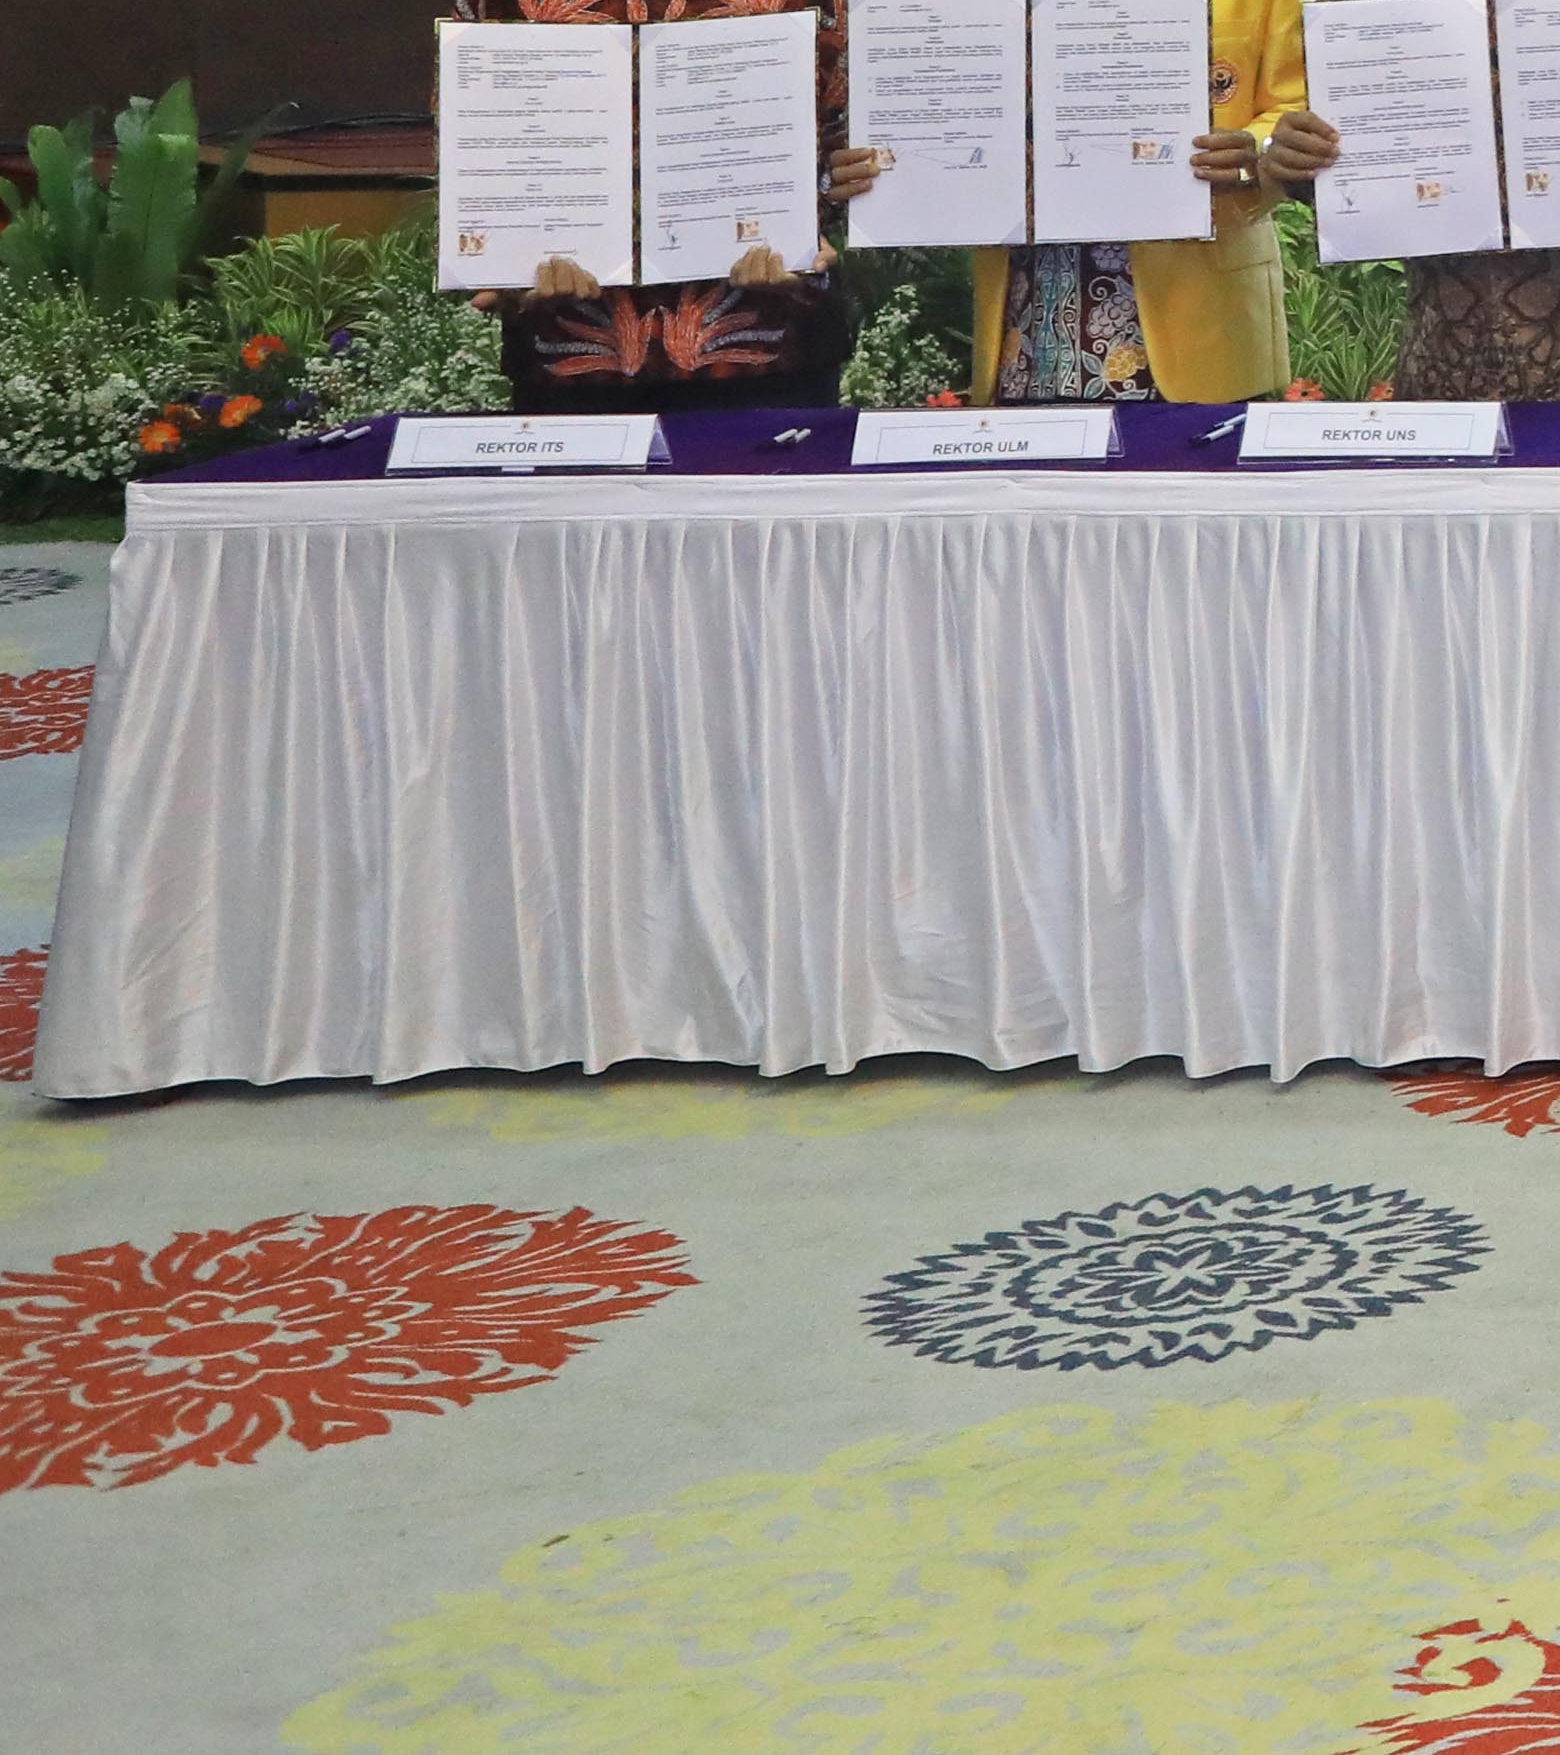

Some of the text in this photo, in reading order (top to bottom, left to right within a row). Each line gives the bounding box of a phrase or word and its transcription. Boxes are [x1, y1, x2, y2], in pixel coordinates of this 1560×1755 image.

[1321, 429, 1417, 441] REKTOR UNS
[475, 441, 565, 454] REKTOR ITS
[932, 440, 1029, 455] REKTOR ULM
